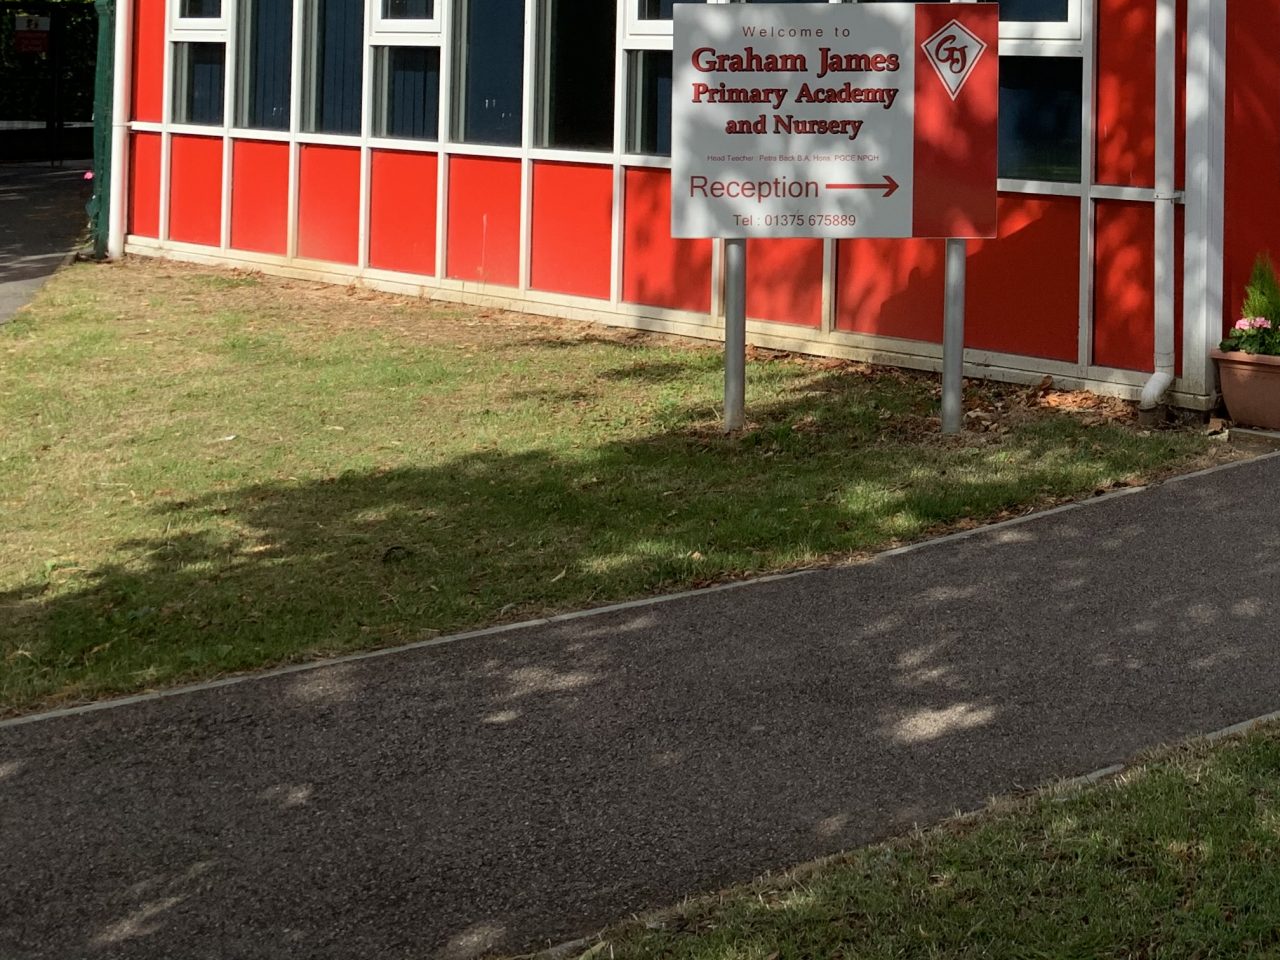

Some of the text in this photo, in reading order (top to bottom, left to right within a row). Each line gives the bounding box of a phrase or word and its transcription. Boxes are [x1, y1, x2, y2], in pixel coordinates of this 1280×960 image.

[742, 25, 851, 38] Welcome to
[691, 47, 900, 78] Graham James
[691, 82, 898, 109] Primary Academy
[725, 114, 864, 140] and Nursery
[707, 154, 725, 162] Head
[727, 154, 753, 162] Teacher
[689, 175, 819, 203] Reception
[733, 214, 753, 227] Tel
[764, 214, 805, 227] 01375
[808, 214, 856, 227] 675889
